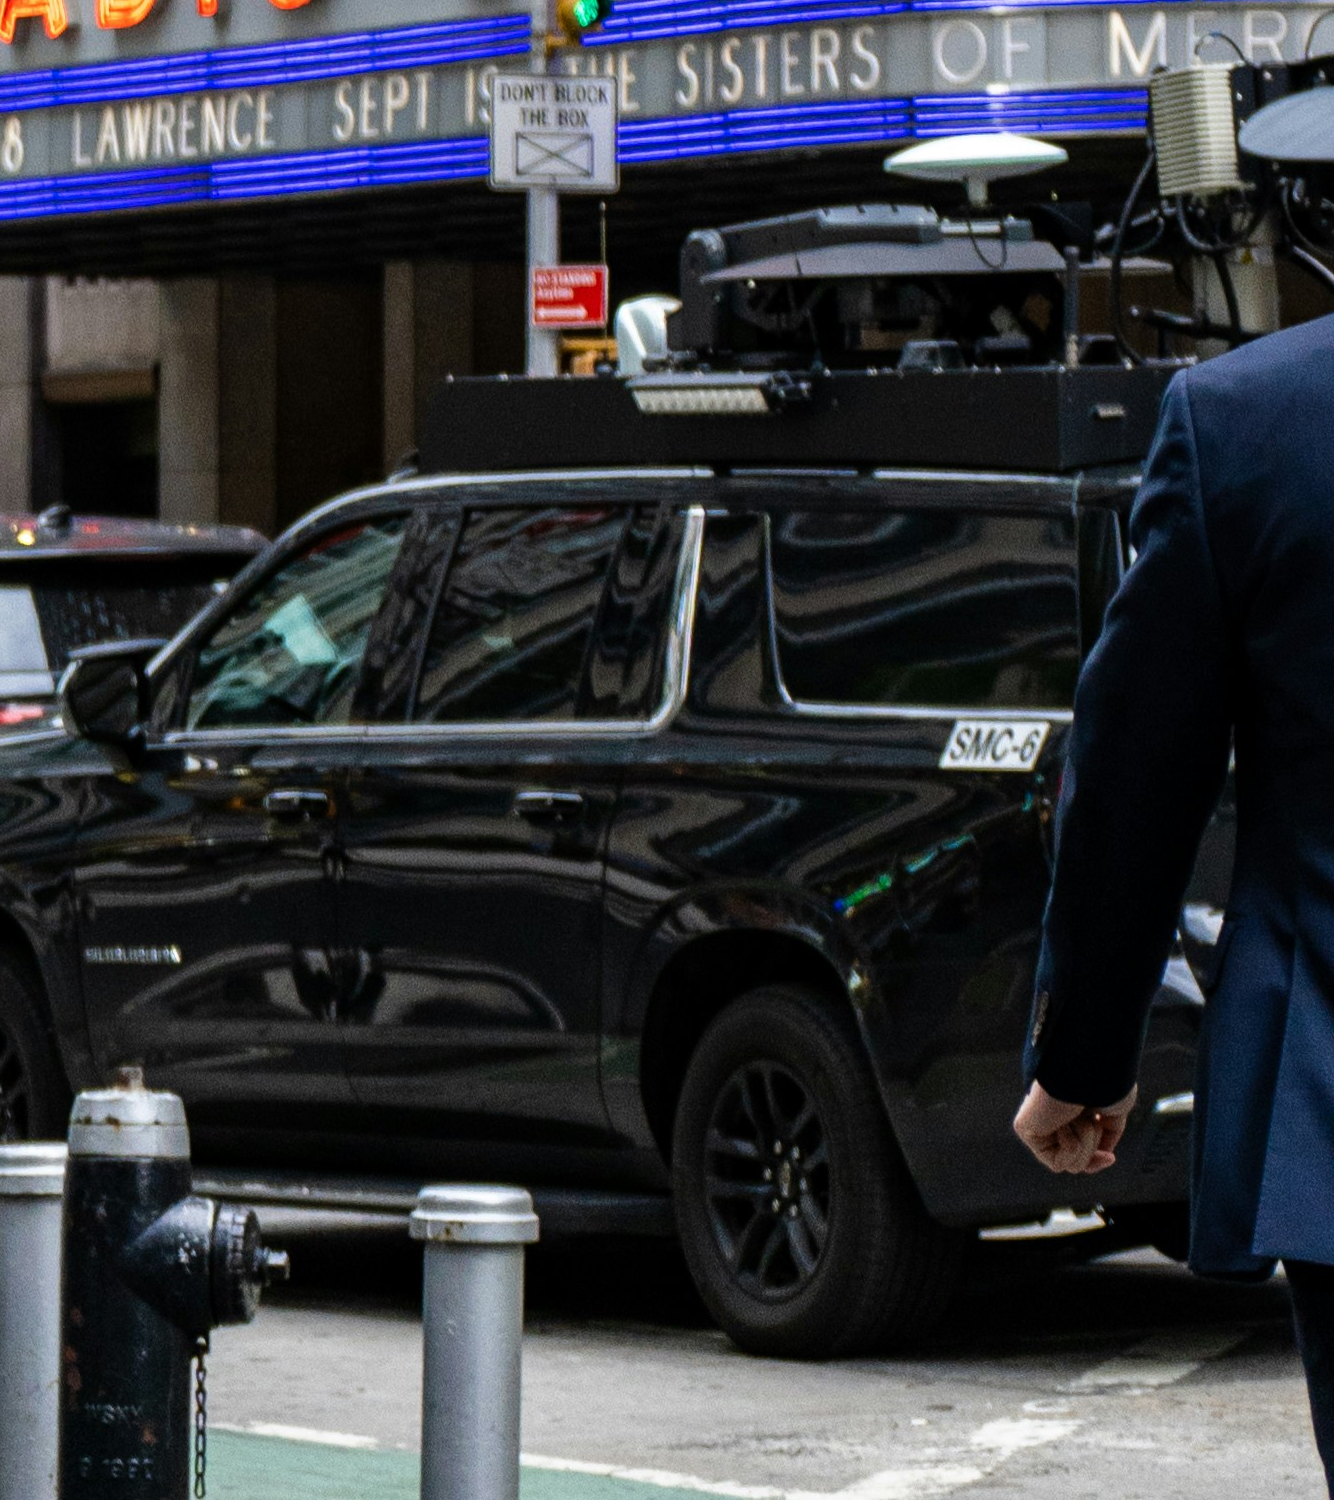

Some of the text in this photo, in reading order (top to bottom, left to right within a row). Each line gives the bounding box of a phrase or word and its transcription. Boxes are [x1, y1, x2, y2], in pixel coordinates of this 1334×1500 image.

[71, 89, 275, 168] LAWRENCE
[333, 71, 434, 144] SEPT
[676, 25, 881, 108] SISTERS
[933, 18, 1036, 86] OF
[500, 82, 608, 102] DON'T BLOCK
[520, 106, 589, 127] THE BOX
[949, 727, 1040, 762] SMC-6
